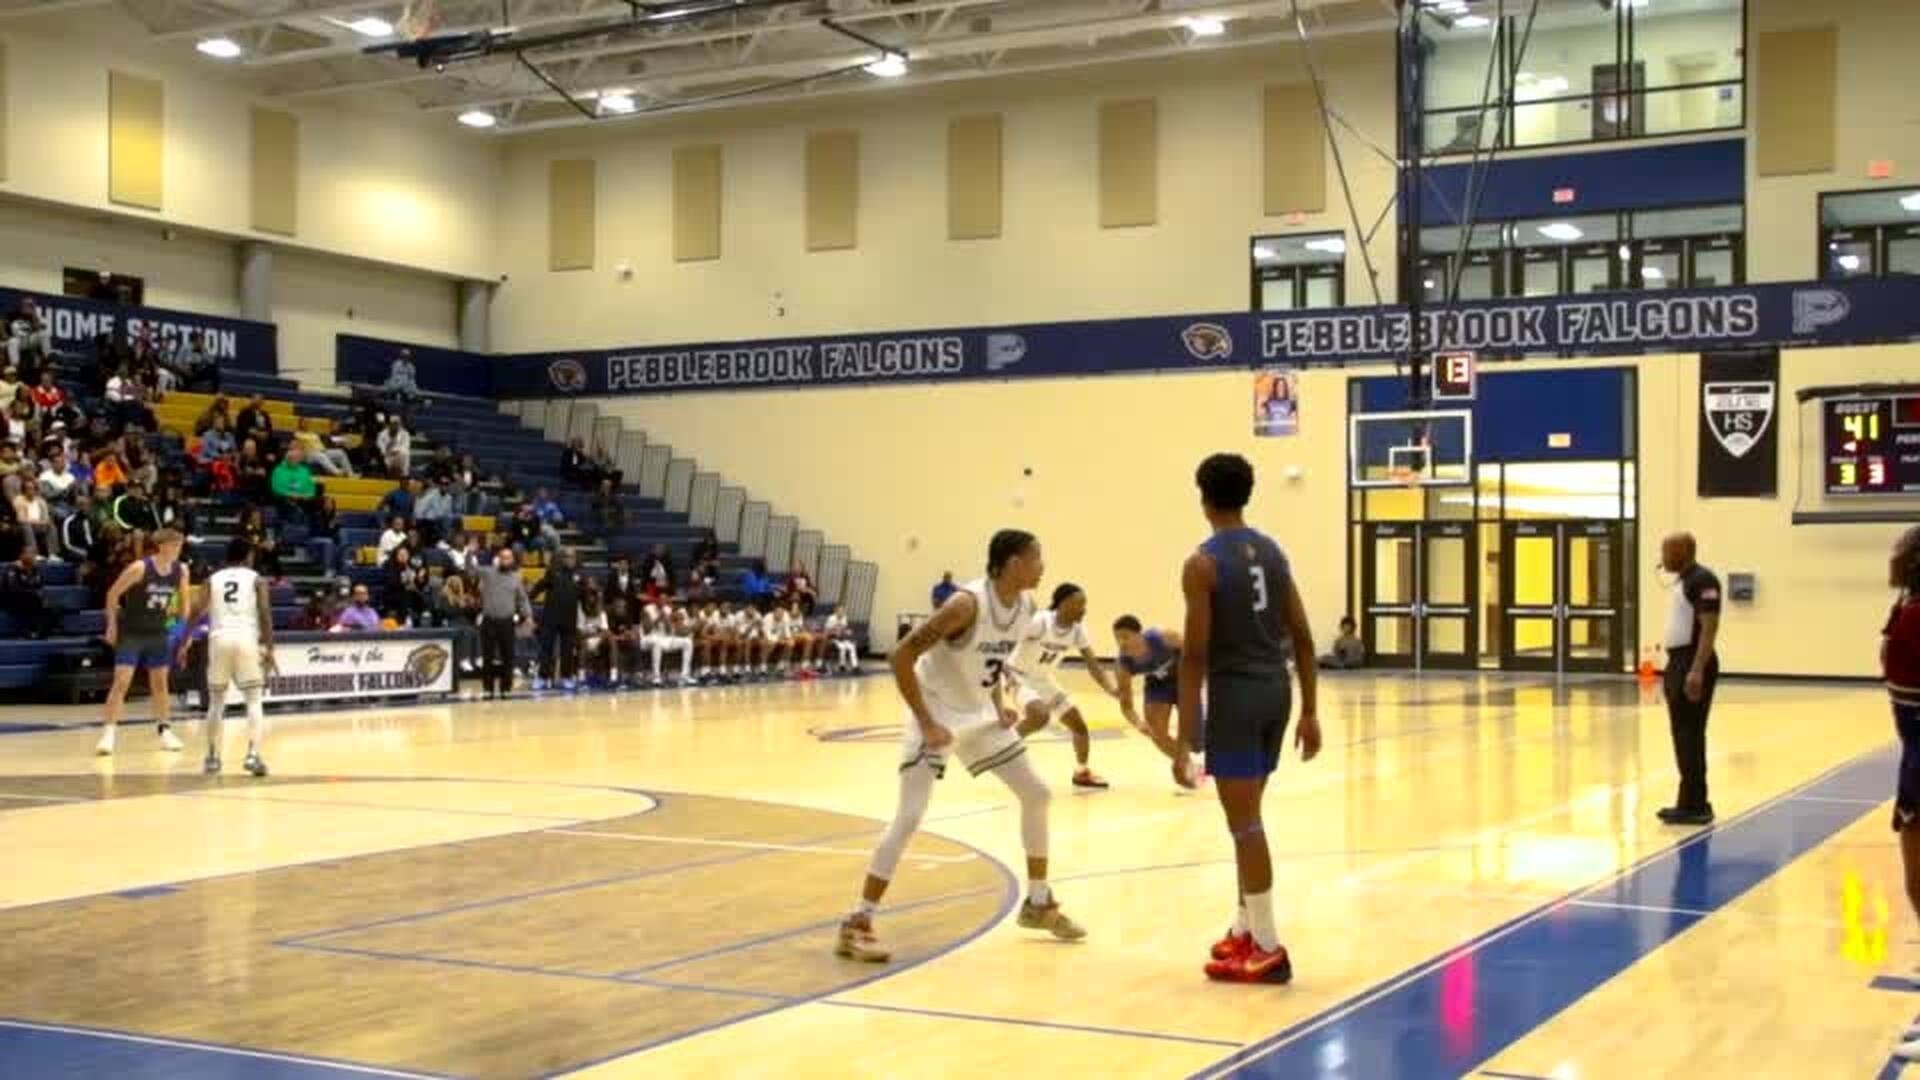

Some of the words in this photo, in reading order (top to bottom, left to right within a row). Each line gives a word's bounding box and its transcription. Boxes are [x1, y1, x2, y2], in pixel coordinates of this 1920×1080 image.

[35, 306, 115, 341] HOME
[127, 318, 236, 360] SECTON
[1261, 305, 1546, 358] PEBBLEBROOK
[1557, 294, 1758, 344] FALCONS
[608, 345, 813, 390] PEBBLEBROOK
[821, 336, 964, 378] FALCONS
[1724, 412, 1753, 431] HS
[1844, 414, 1879, 440] 41
[1840, 463, 1856, 485] 3
[1868, 463, 1885, 485] 3
[223, 581, 239, 604] 2
[1248, 566, 1268, 612] 3
[981, 658, 1004, 688] 3
